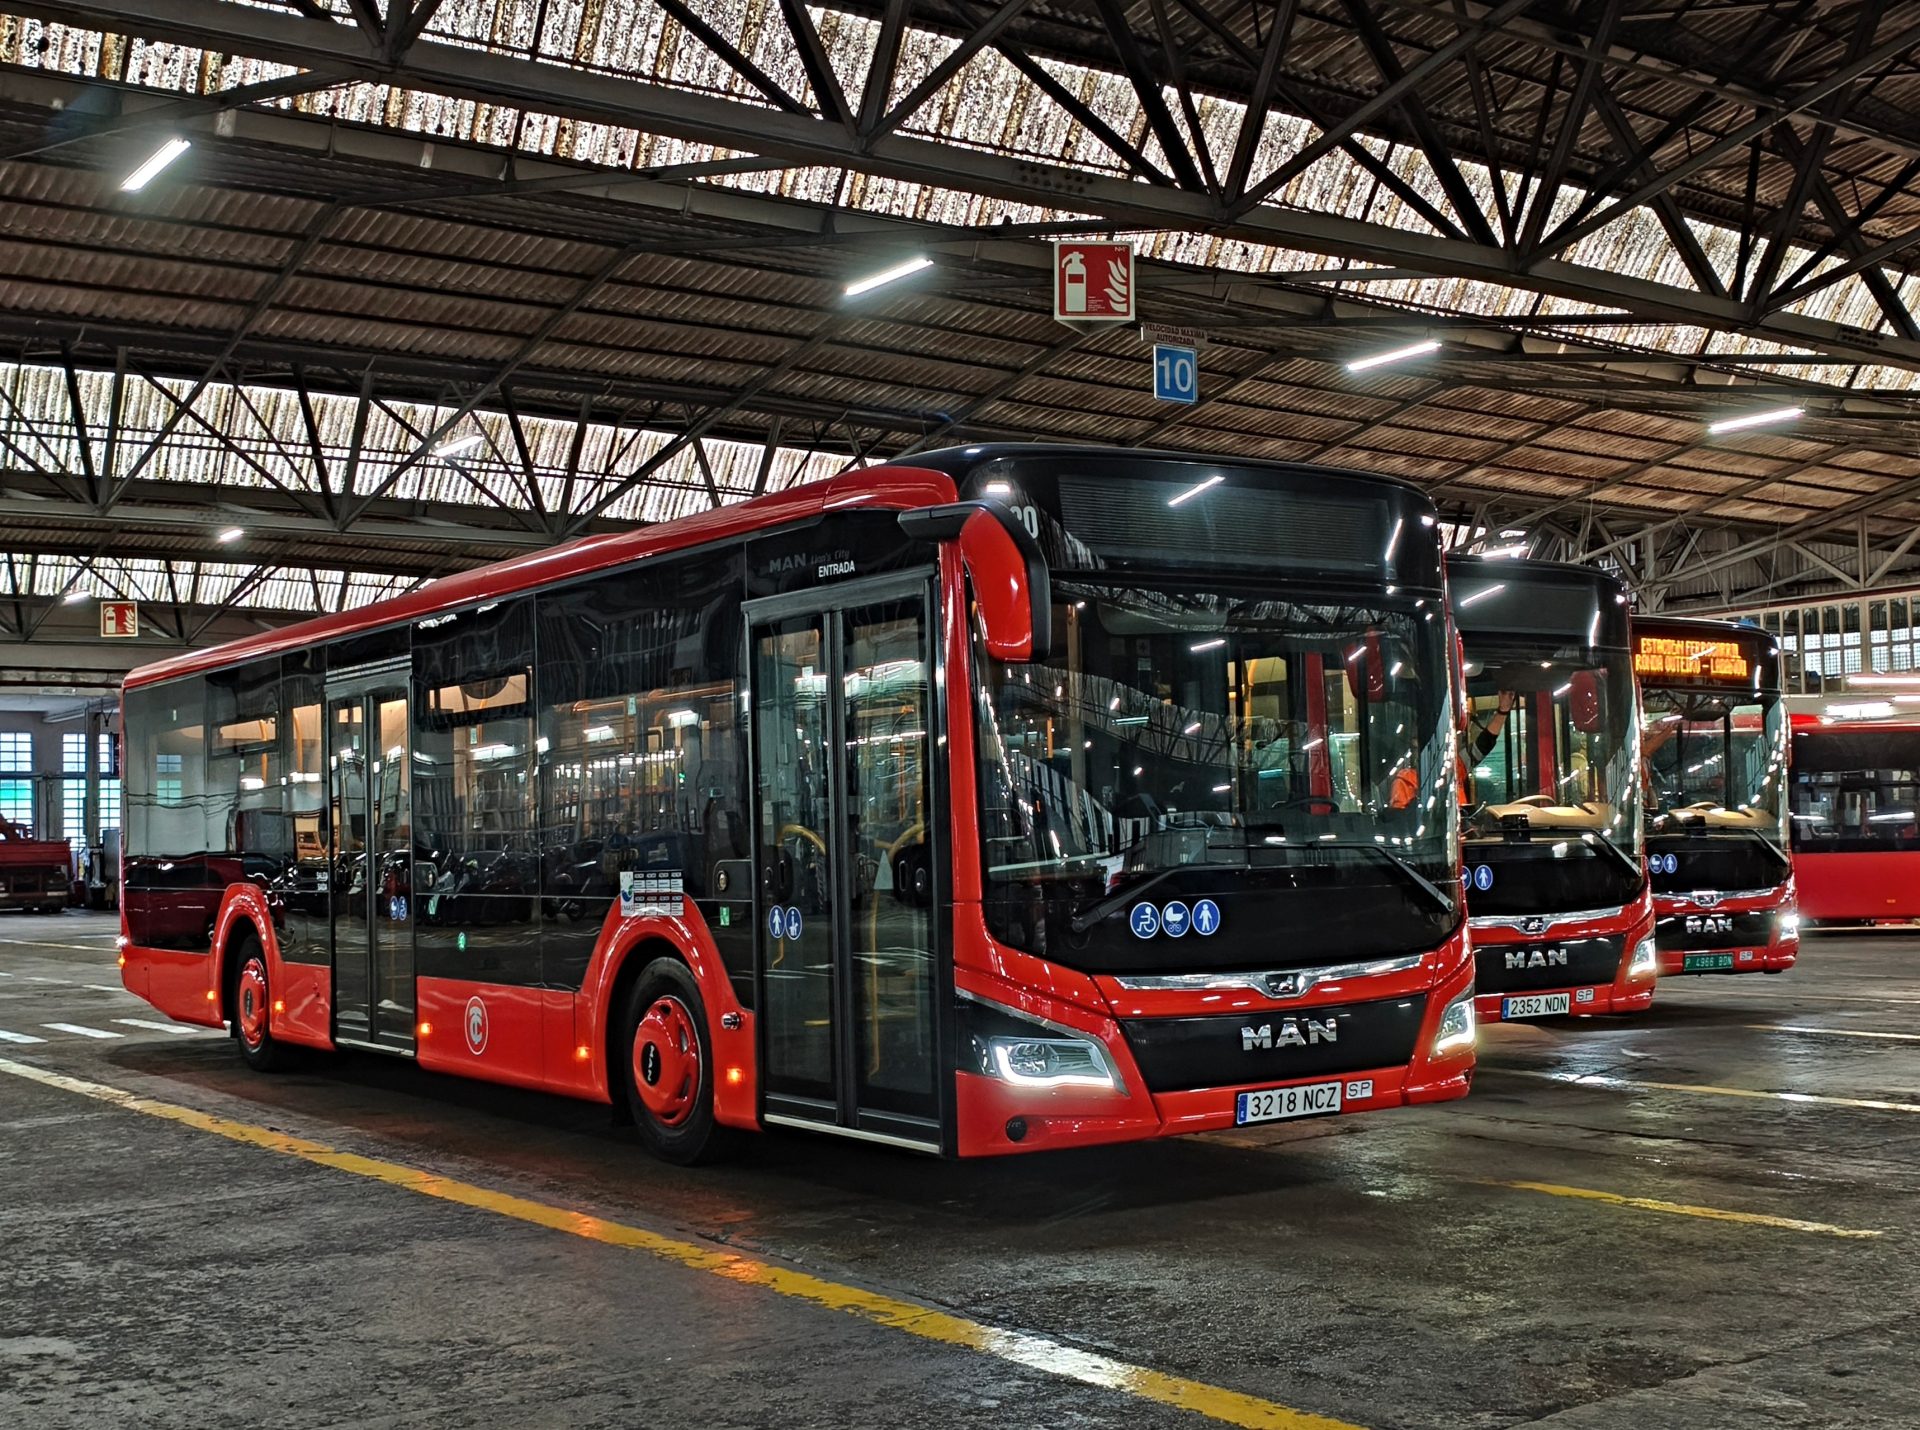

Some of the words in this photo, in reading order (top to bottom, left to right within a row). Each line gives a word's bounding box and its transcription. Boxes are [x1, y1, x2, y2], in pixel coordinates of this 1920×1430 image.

[1145, 322, 1180, 335] VELOCIDAD
[1156, 333, 1196, 346] AUTORIZADA
[1158, 356, 1193, 393] 10
[769, 552, 806, 574] MAN
[818, 560, 856, 578] ENTRADA
[1686, 918, 1733, 934] MAN
[1505, 948, 1568, 969] MAN
[1577, 989, 1593, 1001] SP
[1510, 998, 1541, 1016] 2352
[1544, 996, 1567, 1013] NDN
[1241, 1018, 1337, 1051] MAN
[1348, 1081, 1371, 1097] SP
[1251, 1091, 1297, 1117] 3218
[1303, 1086, 1337, 1111] NCZ
